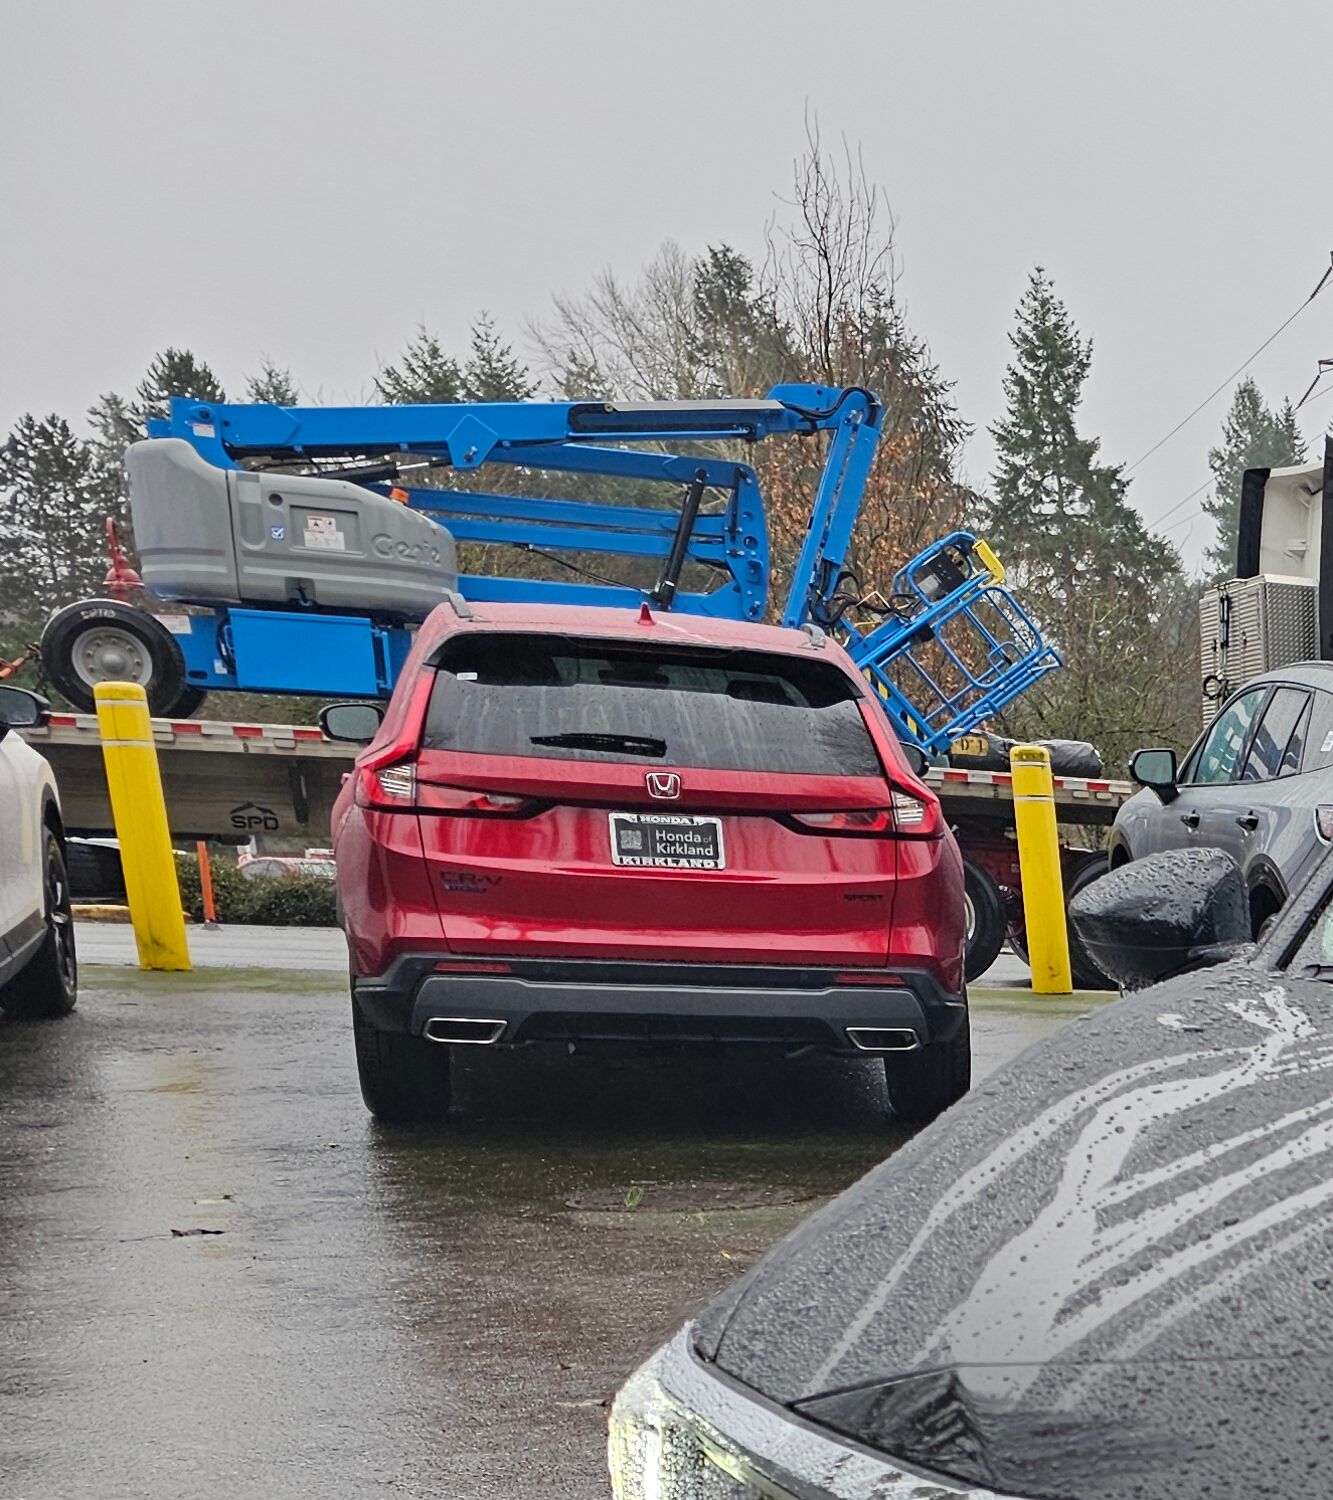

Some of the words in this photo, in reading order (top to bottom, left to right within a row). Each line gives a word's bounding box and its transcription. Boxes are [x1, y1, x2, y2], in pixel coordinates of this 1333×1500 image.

[231, 815, 279, 830] SPD
[640, 815, 690, 825] HONDA
[656, 830, 701, 843] Honda
[703, 835, 712, 843] of
[656, 843, 714, 856] Kirkland
[623, 857, 715, 868] KIRKLAND
